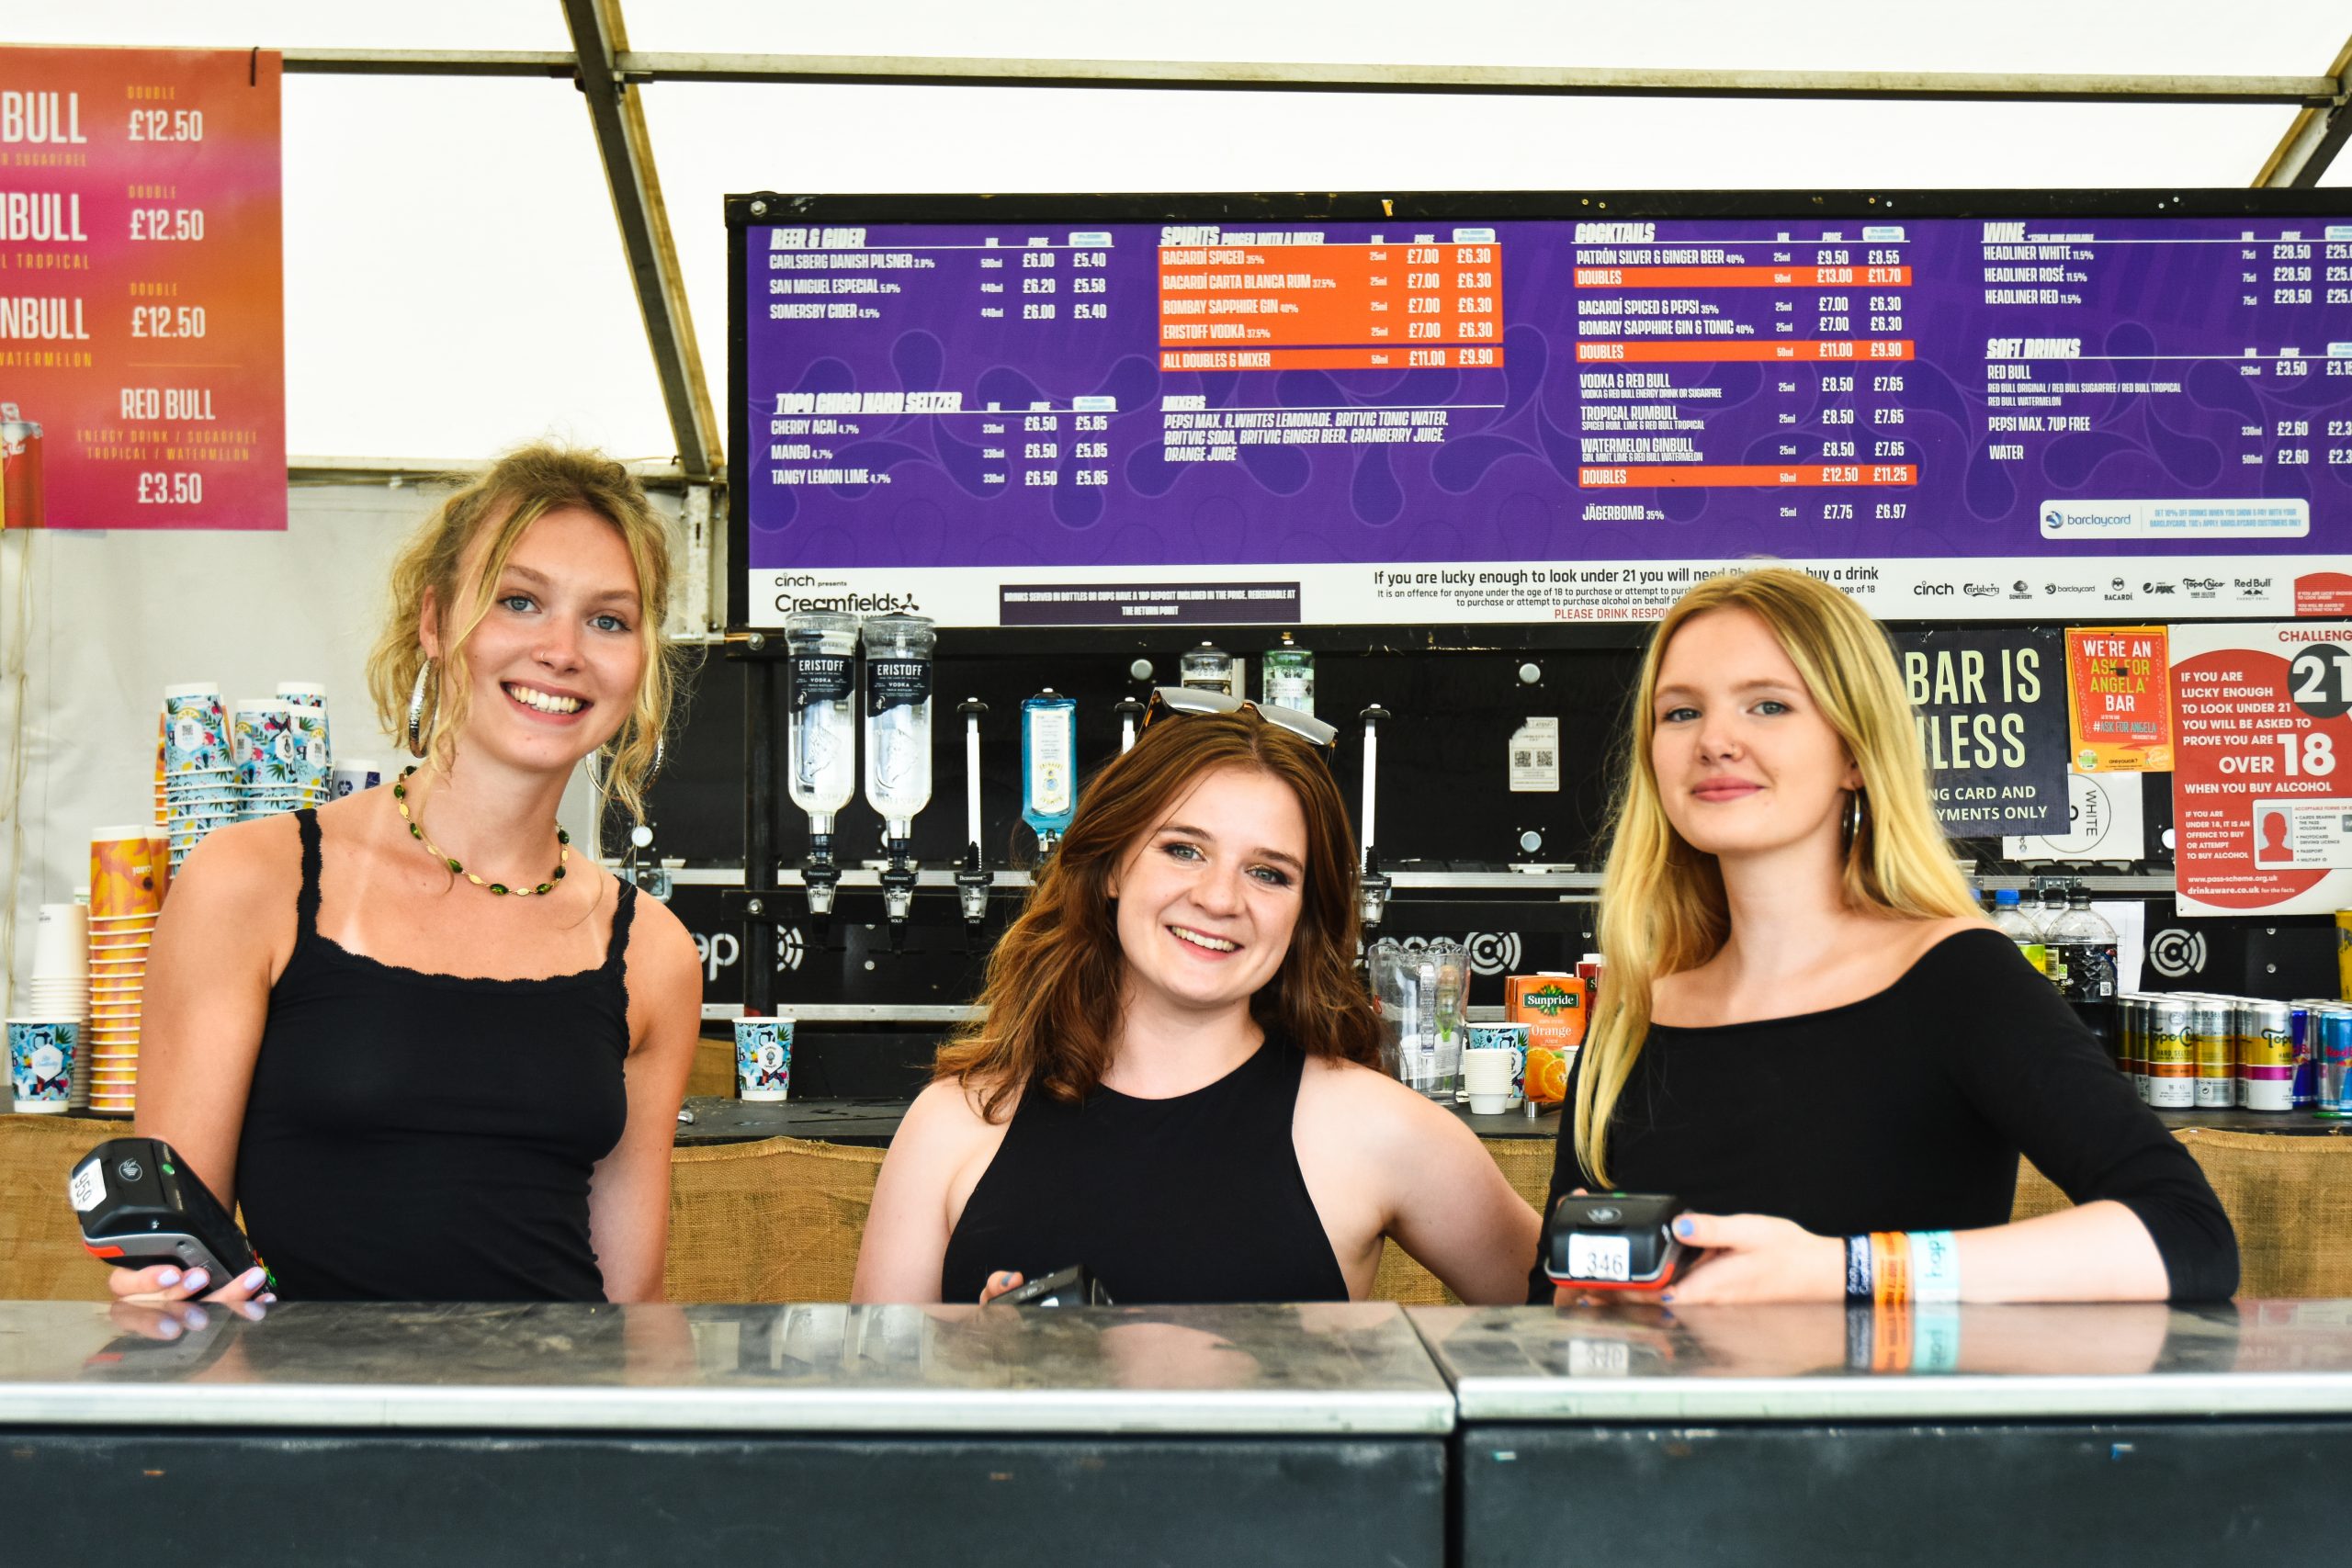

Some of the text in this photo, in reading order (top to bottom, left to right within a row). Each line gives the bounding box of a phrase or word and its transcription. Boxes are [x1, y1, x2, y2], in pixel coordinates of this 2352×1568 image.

[2, 92, 87, 144] BULL
[128, 110, 203, 141] £12.50
[130, 209, 204, 240] £12.50
[1983, 222, 2026, 242] WINE
[770, 228, 866, 248] BEER CIDER
[1161, 226, 1220, 245] SPIRITS
[1574, 223, 1656, 243] COCKTAILS
[1161, 248, 1245, 265] BACARDÍ SPICED
[1576, 248, 1900, 265] PATRÓN SILVER GINGER BEER 40% £9.50 £8.55
[1983, 244, 2312, 260] HEADLINER WHITE £28.50
[17, 254, 89, 270] TROPICAL
[769, 253, 1106, 269] CARLSBERG DANISH PILSNER £6.00 £5.40
[769, 278, 1106, 294] SAN MIGUEL ESPECIAL £6.20 £5.58
[1162, 273, 1311, 289] BACARDÍ CARTA BLANCA RUM
[1162, 299, 1279, 314] BOMBAY SAPPHIRE GIN
[131, 307, 206, 337] £12.50
[1986, 338, 2082, 358] SOFT DRINKS
[1161, 349, 1493, 368] ALL DOUBLES MIXER £11.00 £9.90
[1579, 374, 1671, 388] VODKA RED BULL
[120, 389, 216, 420] RED BULL
[905, 392, 962, 412] SELTZER
[1164, 414, 1193, 428] PEPSI
[1580, 406, 1679, 421] TROPICAL RUMBULL
[771, 420, 811, 434] CHERRY
[1988, 417, 2309, 435] PEPSI 7UP FREE £2.60
[1282, 428, 1413, 444] GINGER CRANBERRY
[771, 445, 811, 459] MANGO
[1163, 446, 1238, 461] ORANGE JUICE
[1581, 438, 1693, 453] WATERMELON GINBULL
[1988, 446, 2024, 459] WATER
[771, 469, 869, 484] TANGY LEMON LIME
[1582, 467, 1907, 484] DOUBLES £12.50 £11.25
[138, 473, 202, 503] £3.50
[1581, 503, 1645, 520] JÄGERBOMB
[2067, 514, 2132, 526] barclaycard
[775, 573, 815, 587] cinch
[1374, 567, 1879, 587] If you are lucky enough to look under 21 you will drink
[2234, 579, 2271, 589] Red Bull
[1576, 588, 1612, 597] purchase
[1962, 582, 2000, 595] Carlsberg
[775, 592, 899, 612] Creamfields
[1601, 596, 1630, 605] alcohol
[1555, 608, 1628, 619] PLEASE DRINK
[2082, 640, 2152, 657] WE'RE AN
[798, 660, 844, 671] ERISTOFF
[876, 664, 922, 675] ERISTOFF
[1905, 648, 2041, 705] BAR IS
[2180, 672, 2243, 682] IF YOU ARE
[2292, 655, 2352, 703] 21
[2181, 687, 2274, 697] LUCKY ENOUGH
[2105, 695, 2135, 711] BAR
[2181, 703, 2290, 714] TO LOOK UNDER 21
[2182, 718, 2312, 729] YOU WILL BE ASKED TO
[2182, 735, 2274, 745] PROVE YOU ARE
[2276, 733, 2336, 775] 18
[2218, 757, 2275, 773] OVER
[1954, 785, 2037, 800] CARD AND
[2184, 782, 2333, 794] WHEN YOU BUY ALCOHOL
[2004, 806, 2048, 819] ONLY
[2085, 789, 2098, 837] WHITE
[1527, 995, 1575, 1007] Sunpride
[1532, 1025, 1573, 1038] Orange
[1586, 1252, 1624, 1276] 346
